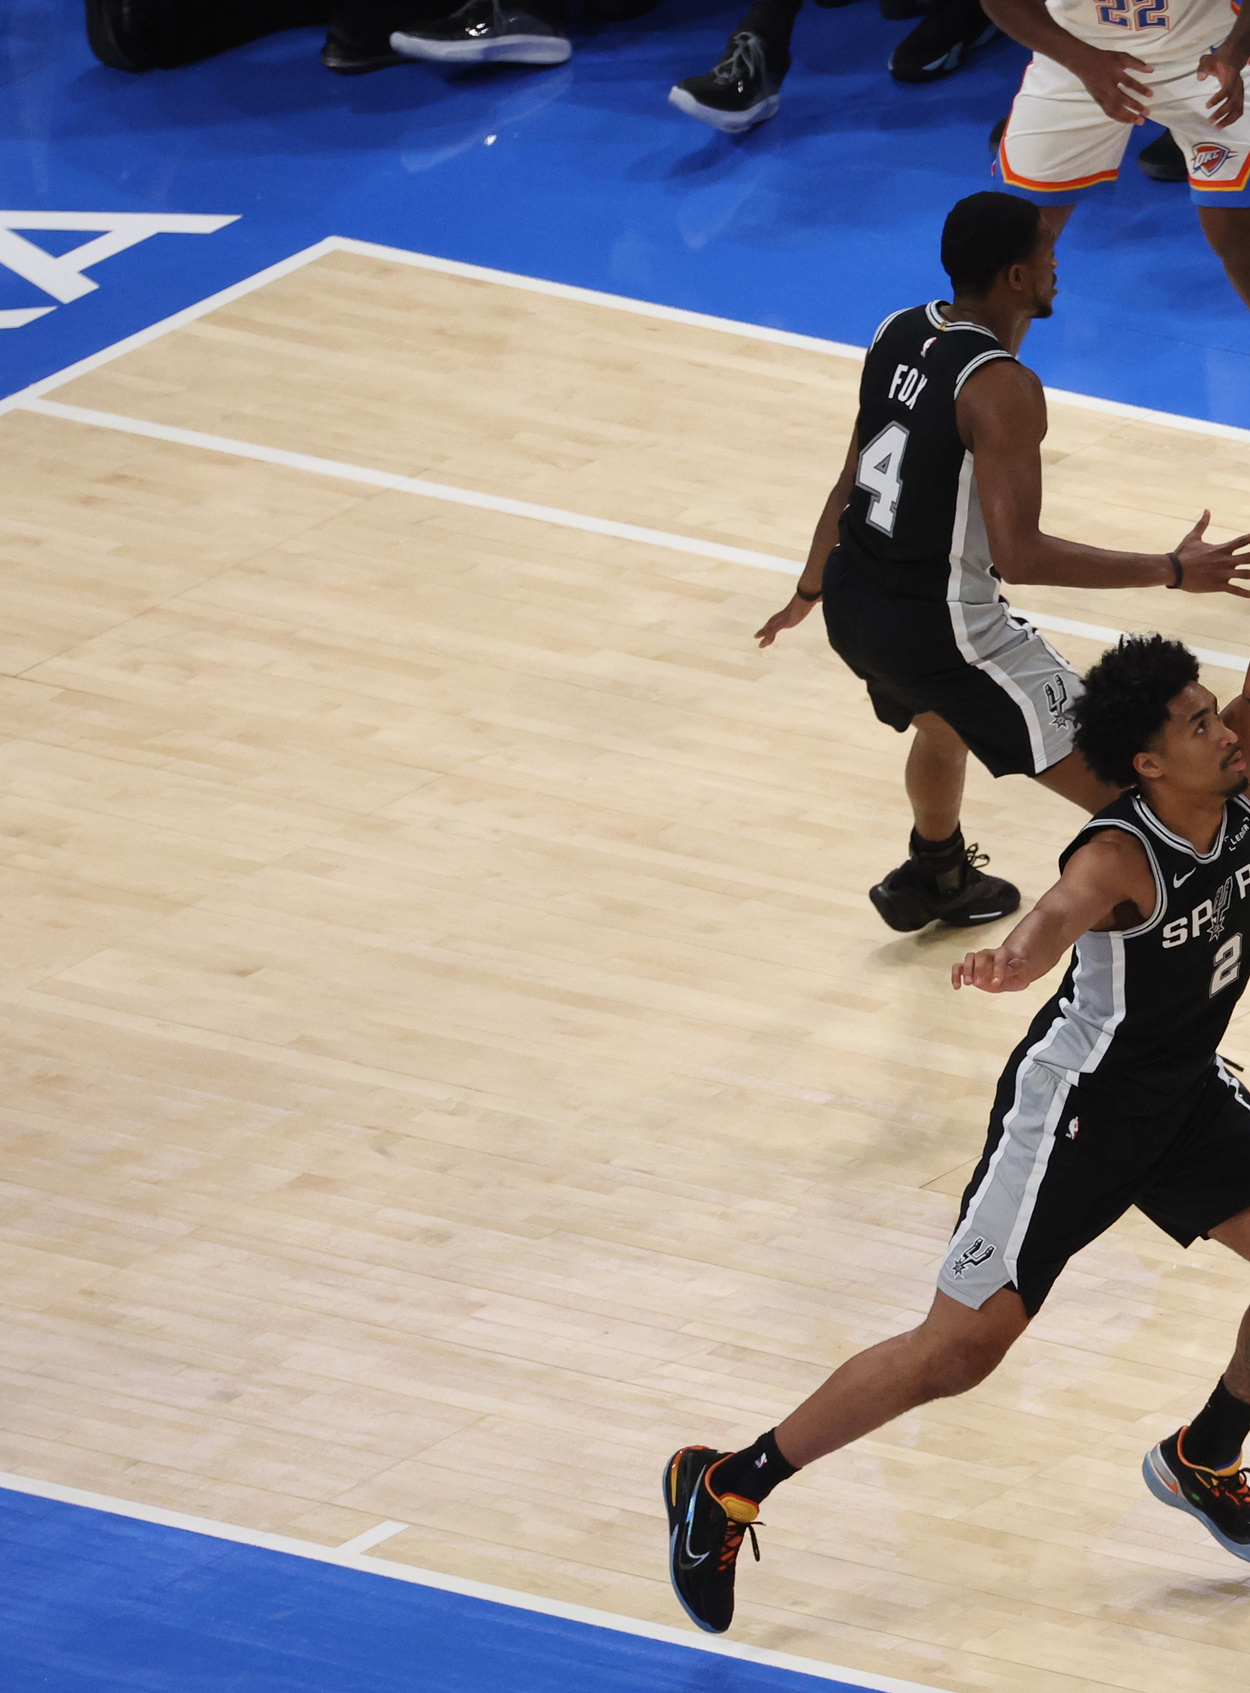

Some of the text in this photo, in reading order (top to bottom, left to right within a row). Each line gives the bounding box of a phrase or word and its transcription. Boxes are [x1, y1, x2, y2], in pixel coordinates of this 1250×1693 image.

[1096, 0, 1170, 31] 22
[888, 363, 928, 410] FOX
[855, 420, 910, 539] 4
[1209, 931, 1244, 999] 2
